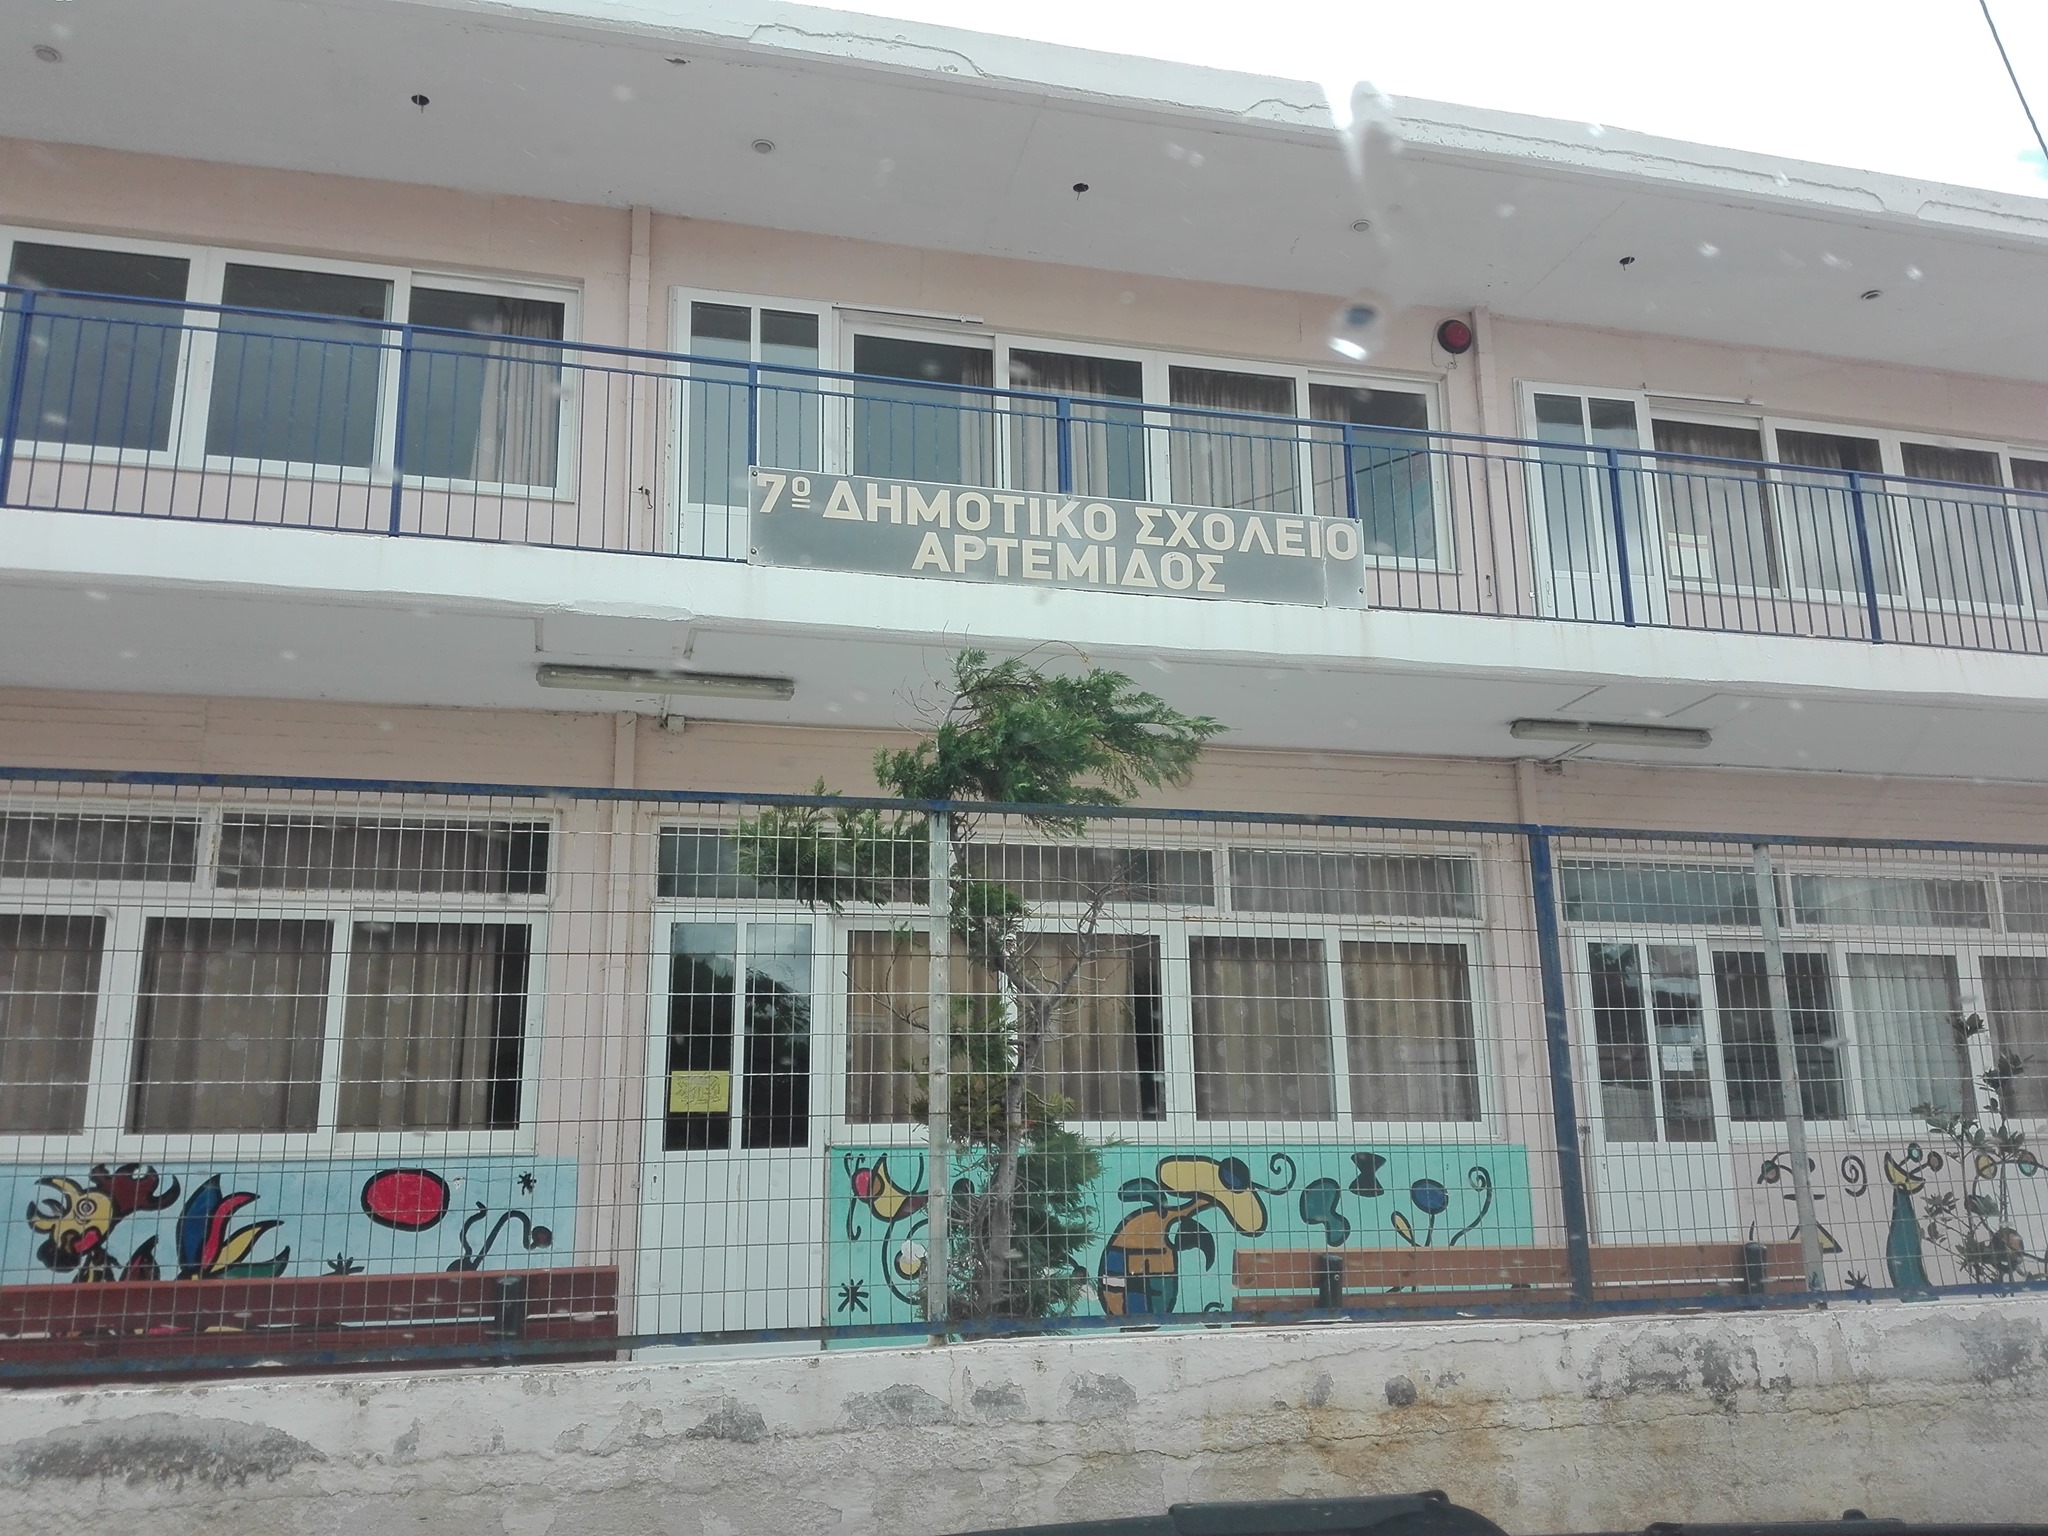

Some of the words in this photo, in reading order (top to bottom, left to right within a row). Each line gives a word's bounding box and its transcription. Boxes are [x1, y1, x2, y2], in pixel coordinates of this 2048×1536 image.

[822, 480, 1117, 542] ΔΗΜΟΤΙΚΟ
[1135, 506, 1358, 561] ΣΧΟΛΕΙΟ
[911, 531, 1226, 593] ΑΡΤΕΜΙΔΟΣ
